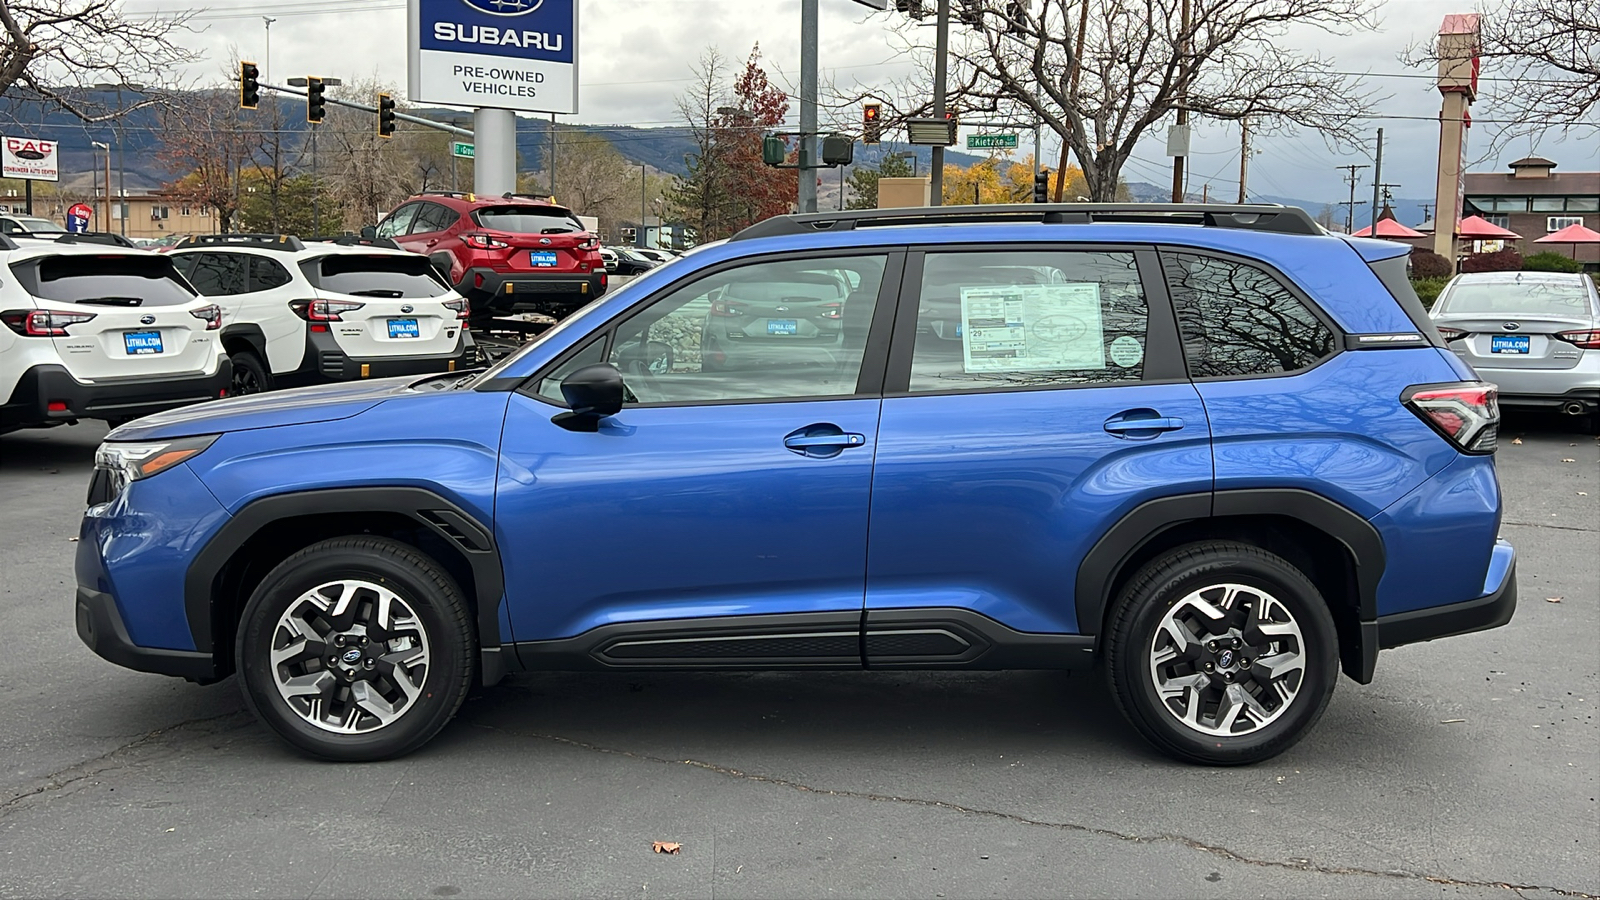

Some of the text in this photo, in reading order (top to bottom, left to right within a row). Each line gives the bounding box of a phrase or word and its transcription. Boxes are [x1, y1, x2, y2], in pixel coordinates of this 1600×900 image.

[434, 22, 562, 51] SUBARU
[453, 65, 545, 83] PRE-OWNED
[462, 81, 536, 97] VEHICLES
[7, 139, 52, 153] CAC
[389, 324, 418, 332] LITHIA.COM
[126, 338, 161, 347] LITHIA.COM
[1492, 340, 1529, 349] LITHIA.COM
